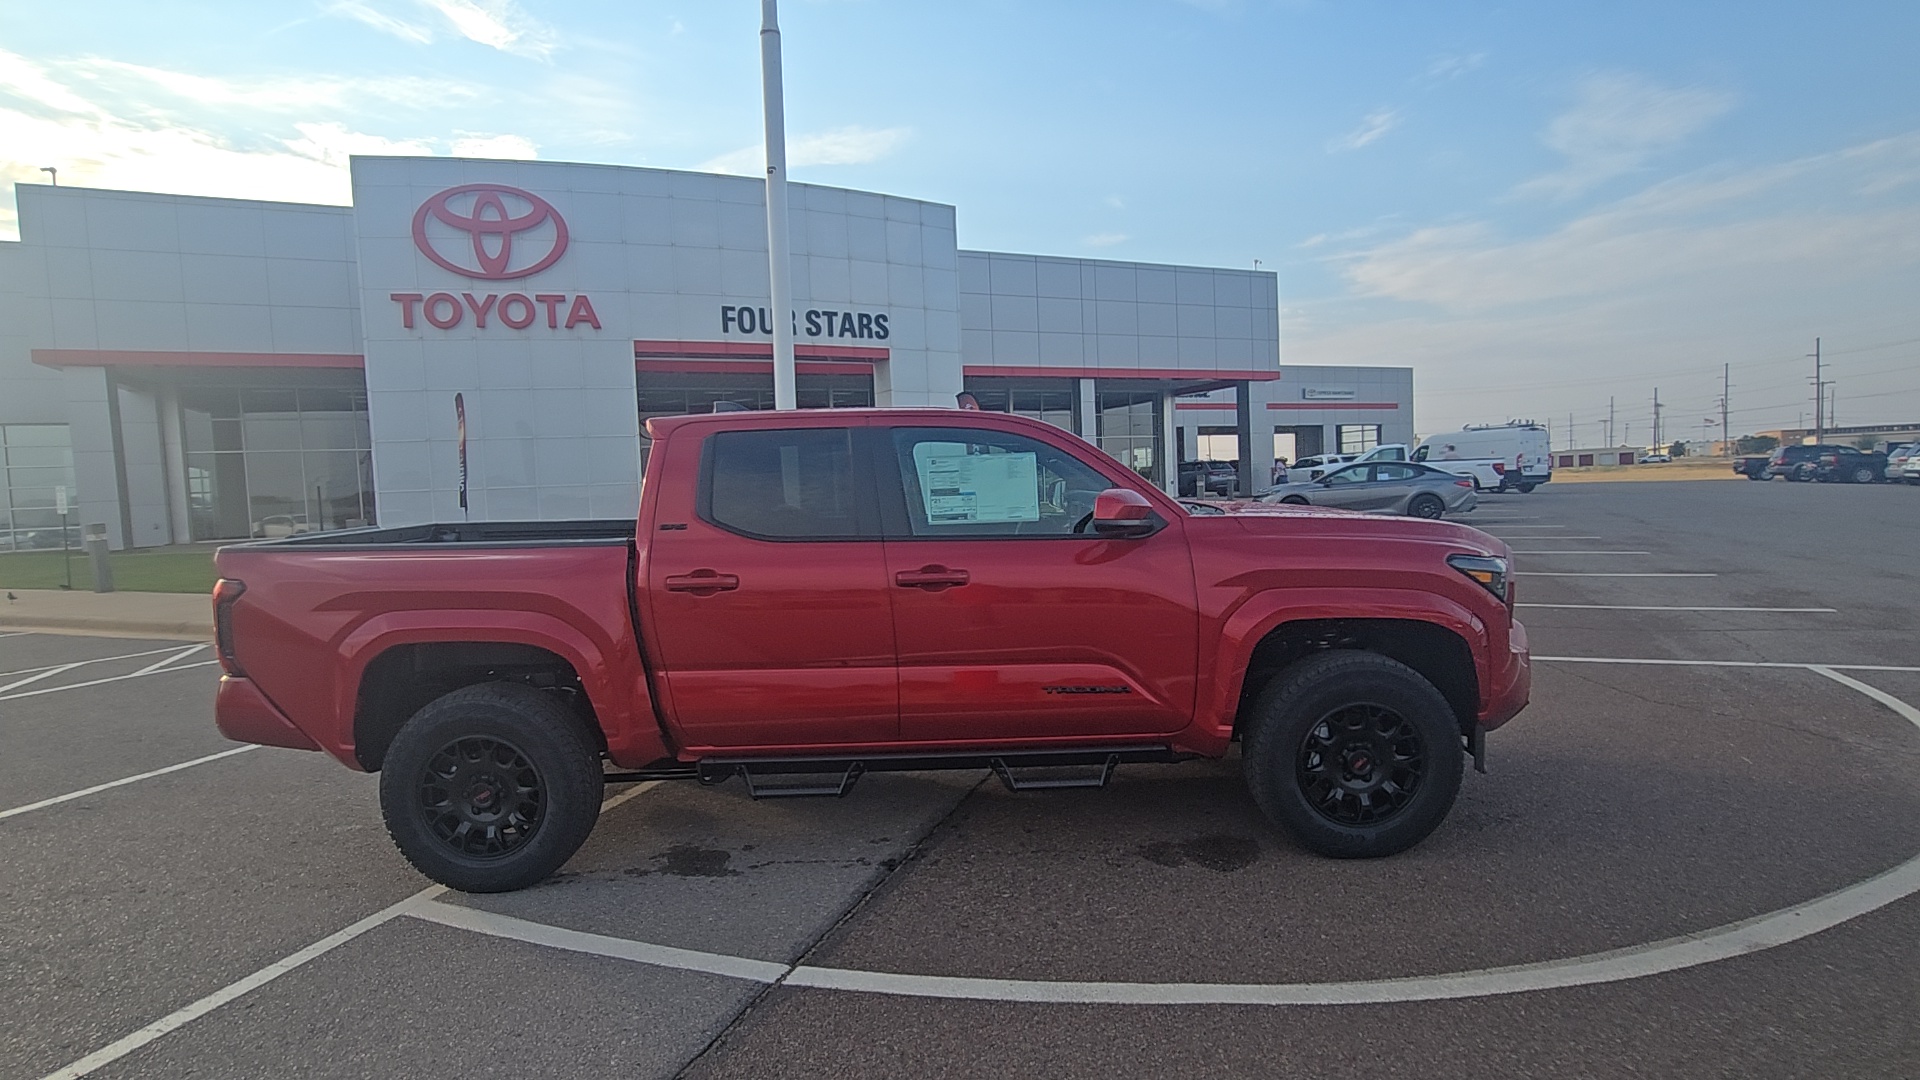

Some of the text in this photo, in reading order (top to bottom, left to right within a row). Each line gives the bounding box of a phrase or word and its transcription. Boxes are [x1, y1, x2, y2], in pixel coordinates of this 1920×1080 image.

[390, 292, 602, 329] TOYOTA
[721, 305, 889, 339] FOU STARS
